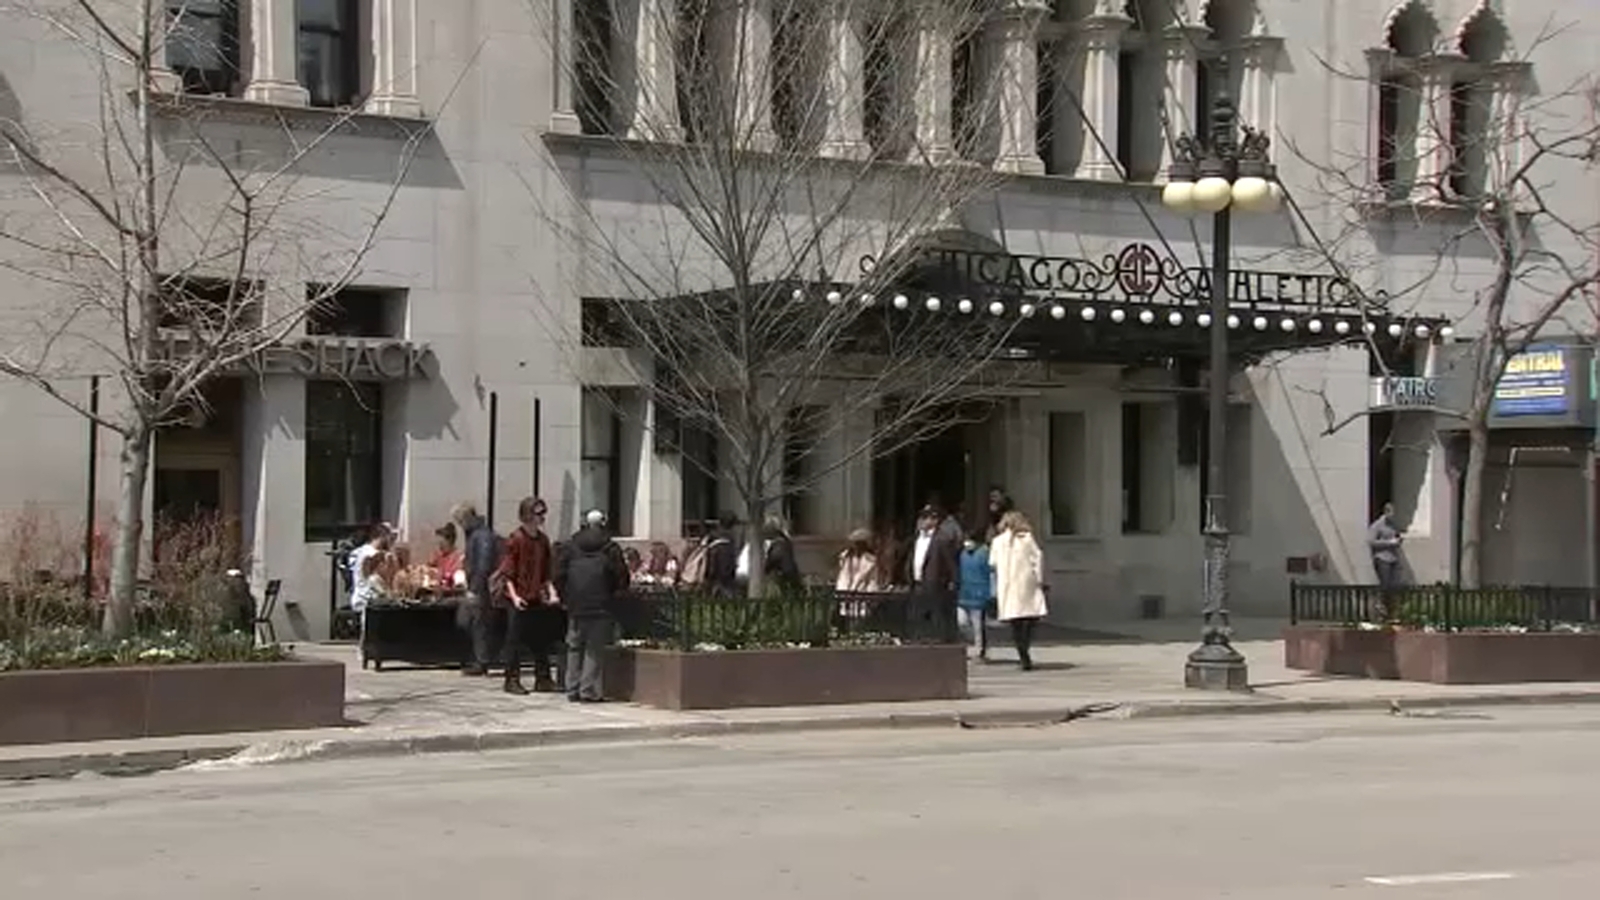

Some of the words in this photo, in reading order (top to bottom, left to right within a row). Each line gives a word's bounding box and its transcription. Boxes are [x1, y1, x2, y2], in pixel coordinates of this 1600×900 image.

[913, 248, 1081, 291] HICAGO
[1196, 268, 1351, 306] AHLETIC
[294, 338, 432, 379] SHACK
